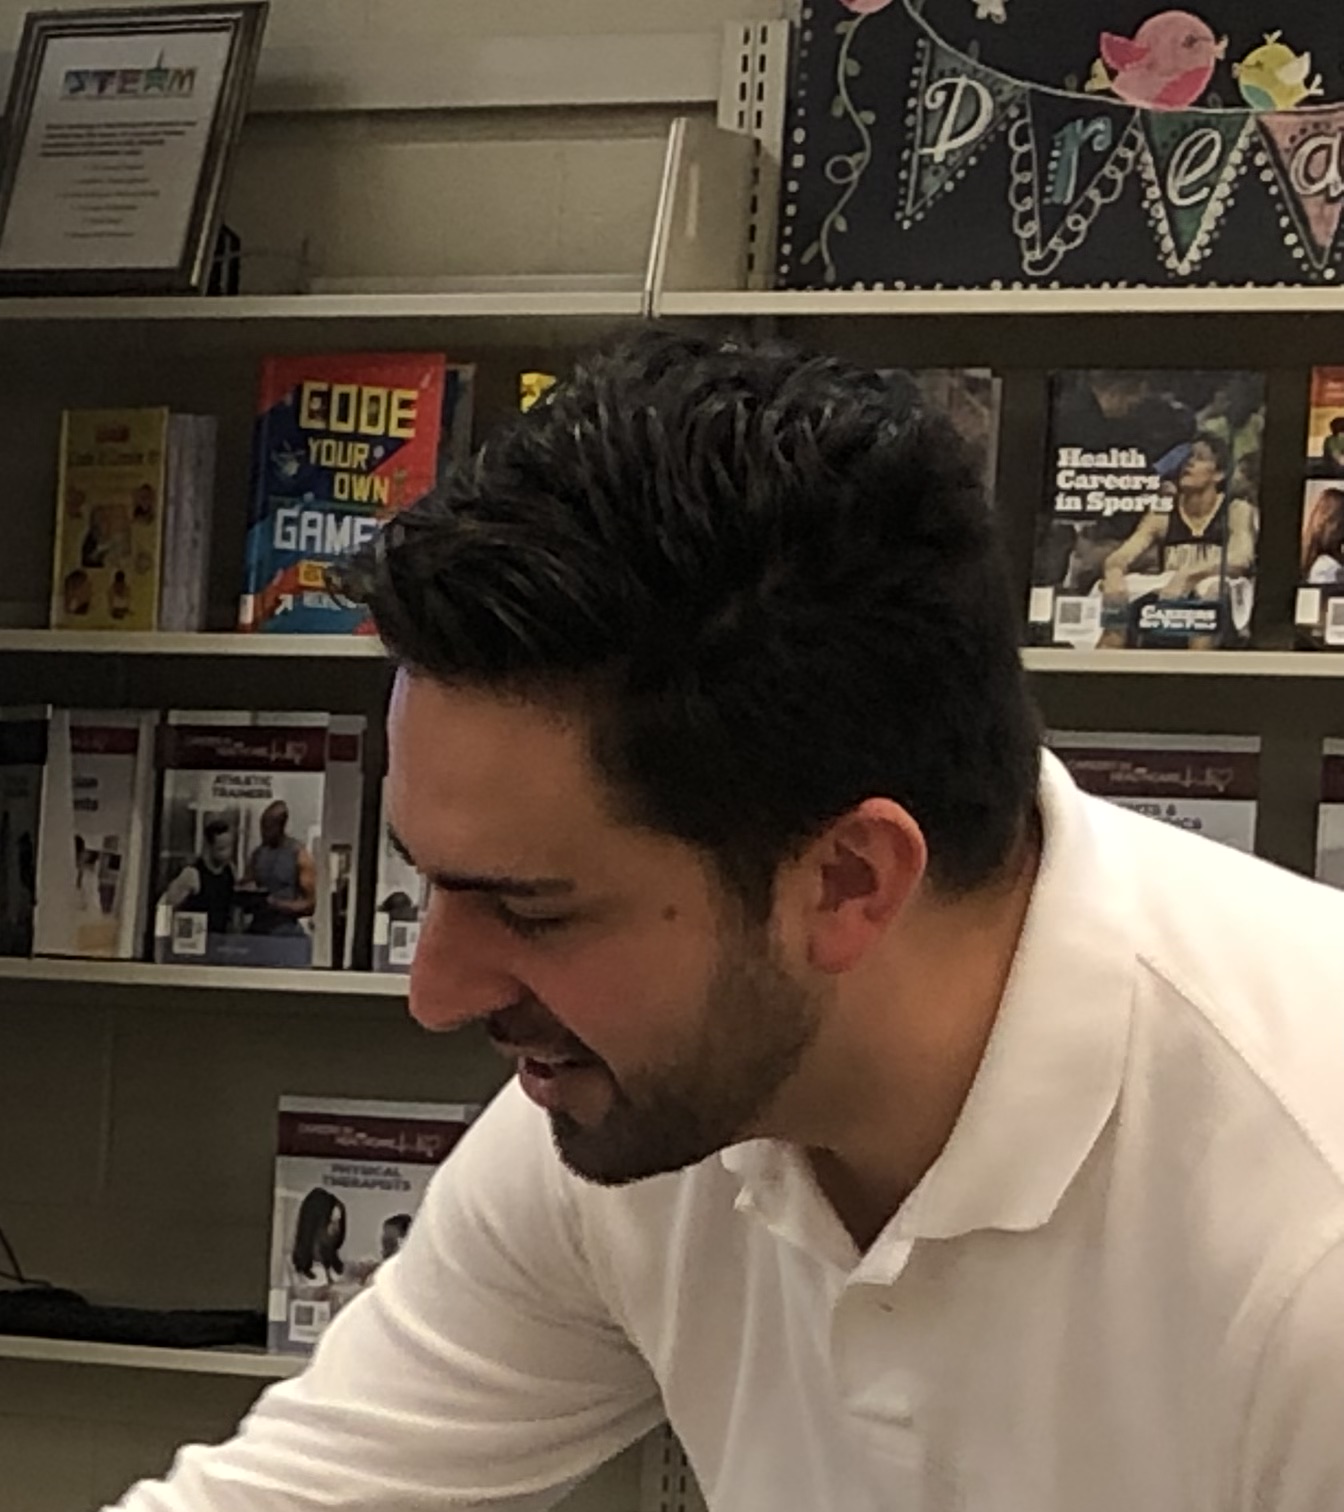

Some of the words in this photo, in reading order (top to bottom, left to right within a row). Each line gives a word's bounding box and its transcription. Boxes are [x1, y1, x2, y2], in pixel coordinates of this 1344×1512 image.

[298, 380, 419, 438] CODE
[307, 437, 371, 470] YOUR
[1058, 448, 1146, 469] Health
[333, 472, 390, 504] OWN
[1056, 471, 1161, 491] Careers
[1055, 494, 1082, 512] in
[1086, 493, 1175, 516] Sports
[273, 505, 389, 556] GAME
